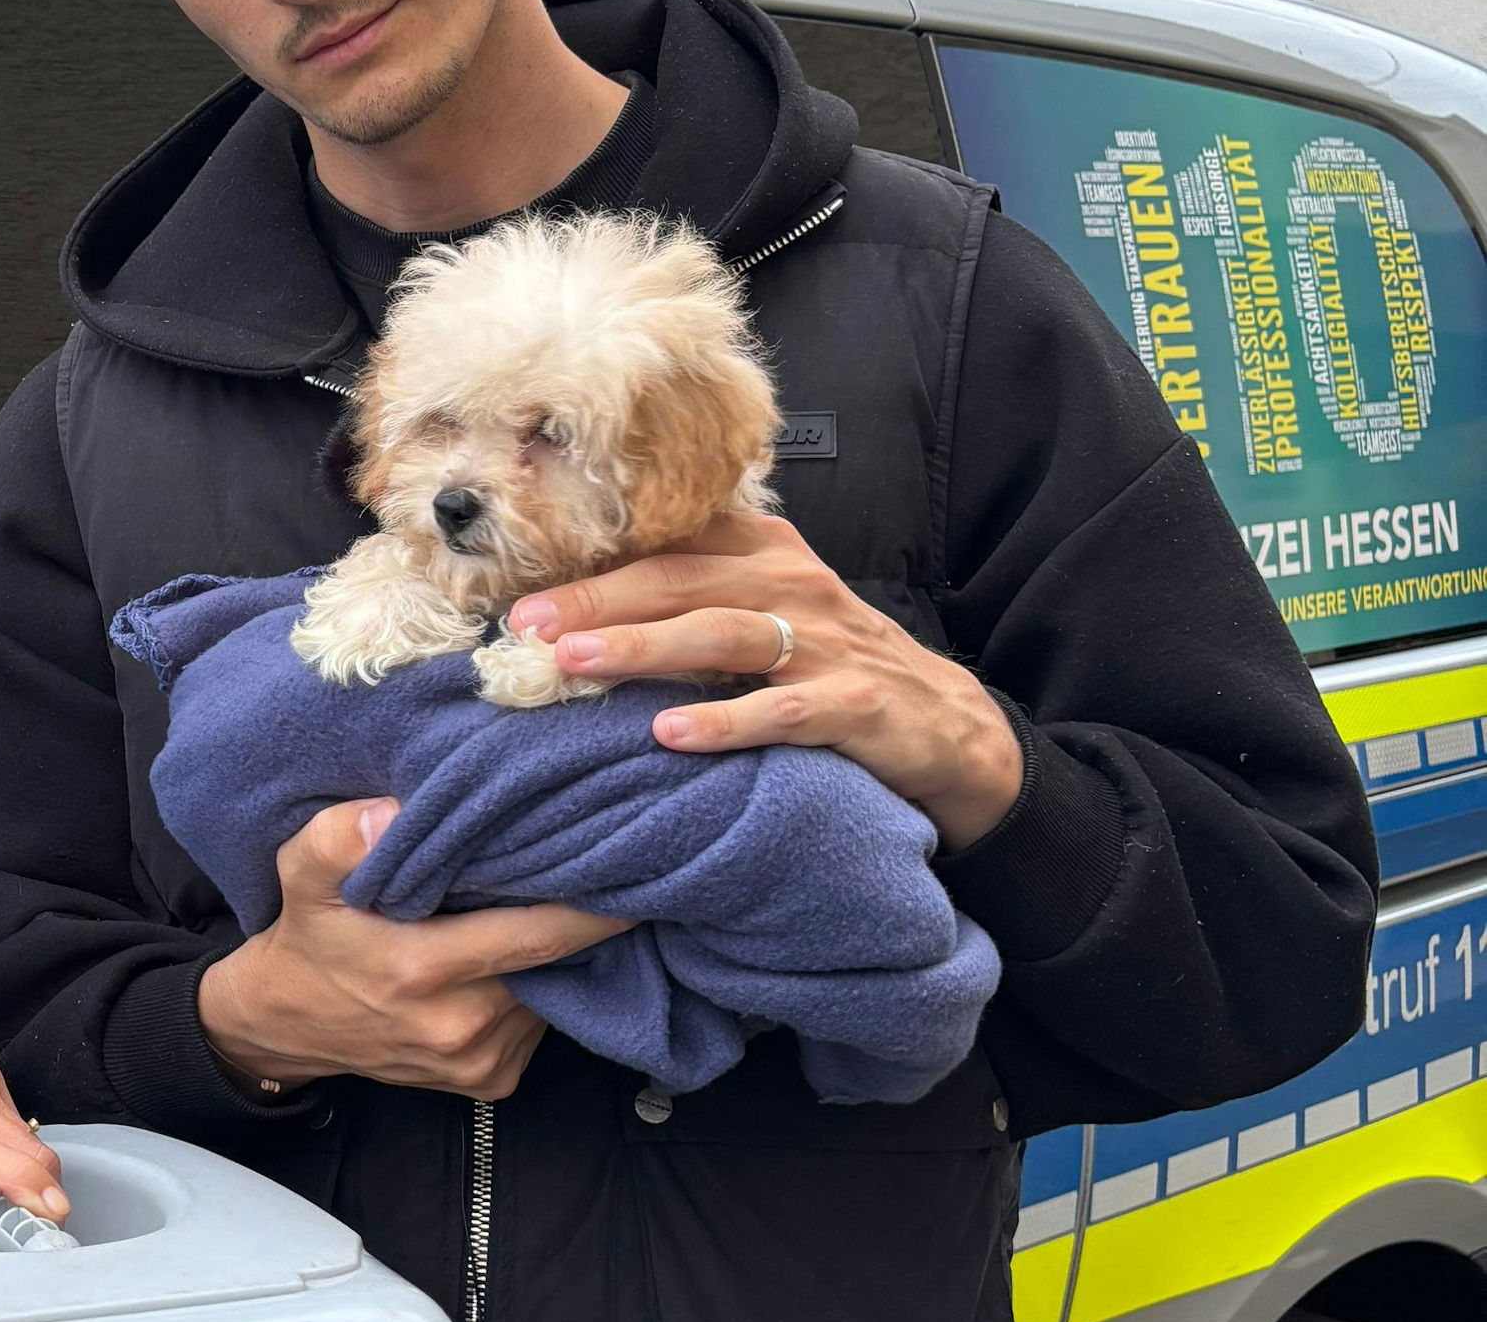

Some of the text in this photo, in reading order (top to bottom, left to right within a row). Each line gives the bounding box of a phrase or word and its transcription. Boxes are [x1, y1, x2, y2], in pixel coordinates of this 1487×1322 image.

[1083, 183, 1126, 203] TEAMGEIST
[1202, 146, 1235, 237] FÜRSORGE
[1306, 165, 1382, 194] WERTSCHÄTZUNG
[1116, 204, 1143, 289] TRANSPARENZ
[1181, 216, 1215, 237] RESPEKT
[1221, 134, 1302, 459] PROFESSIONALITÄT
[1293, 248, 1330, 386] ACHTSAMKEIT
[1308, 220, 1360, 419] KOLLEGIALITÄT
[1366, 196, 1422, 430] HILFSBEREITSCHAFT
[1390, 226, 1431, 353] RESPEKT
[1130, 291, 1158, 386] NTIERUNG
[1226, 257, 1277, 474] ZUVERLÄSSIGKEIT
[1354, 428, 1402, 457] TEAMGEIST
[1322, 499, 1459, 570] HESSEN
[1279, 588, 1347, 624] UNSERE
[1366, 933, 1440, 1036] truf
